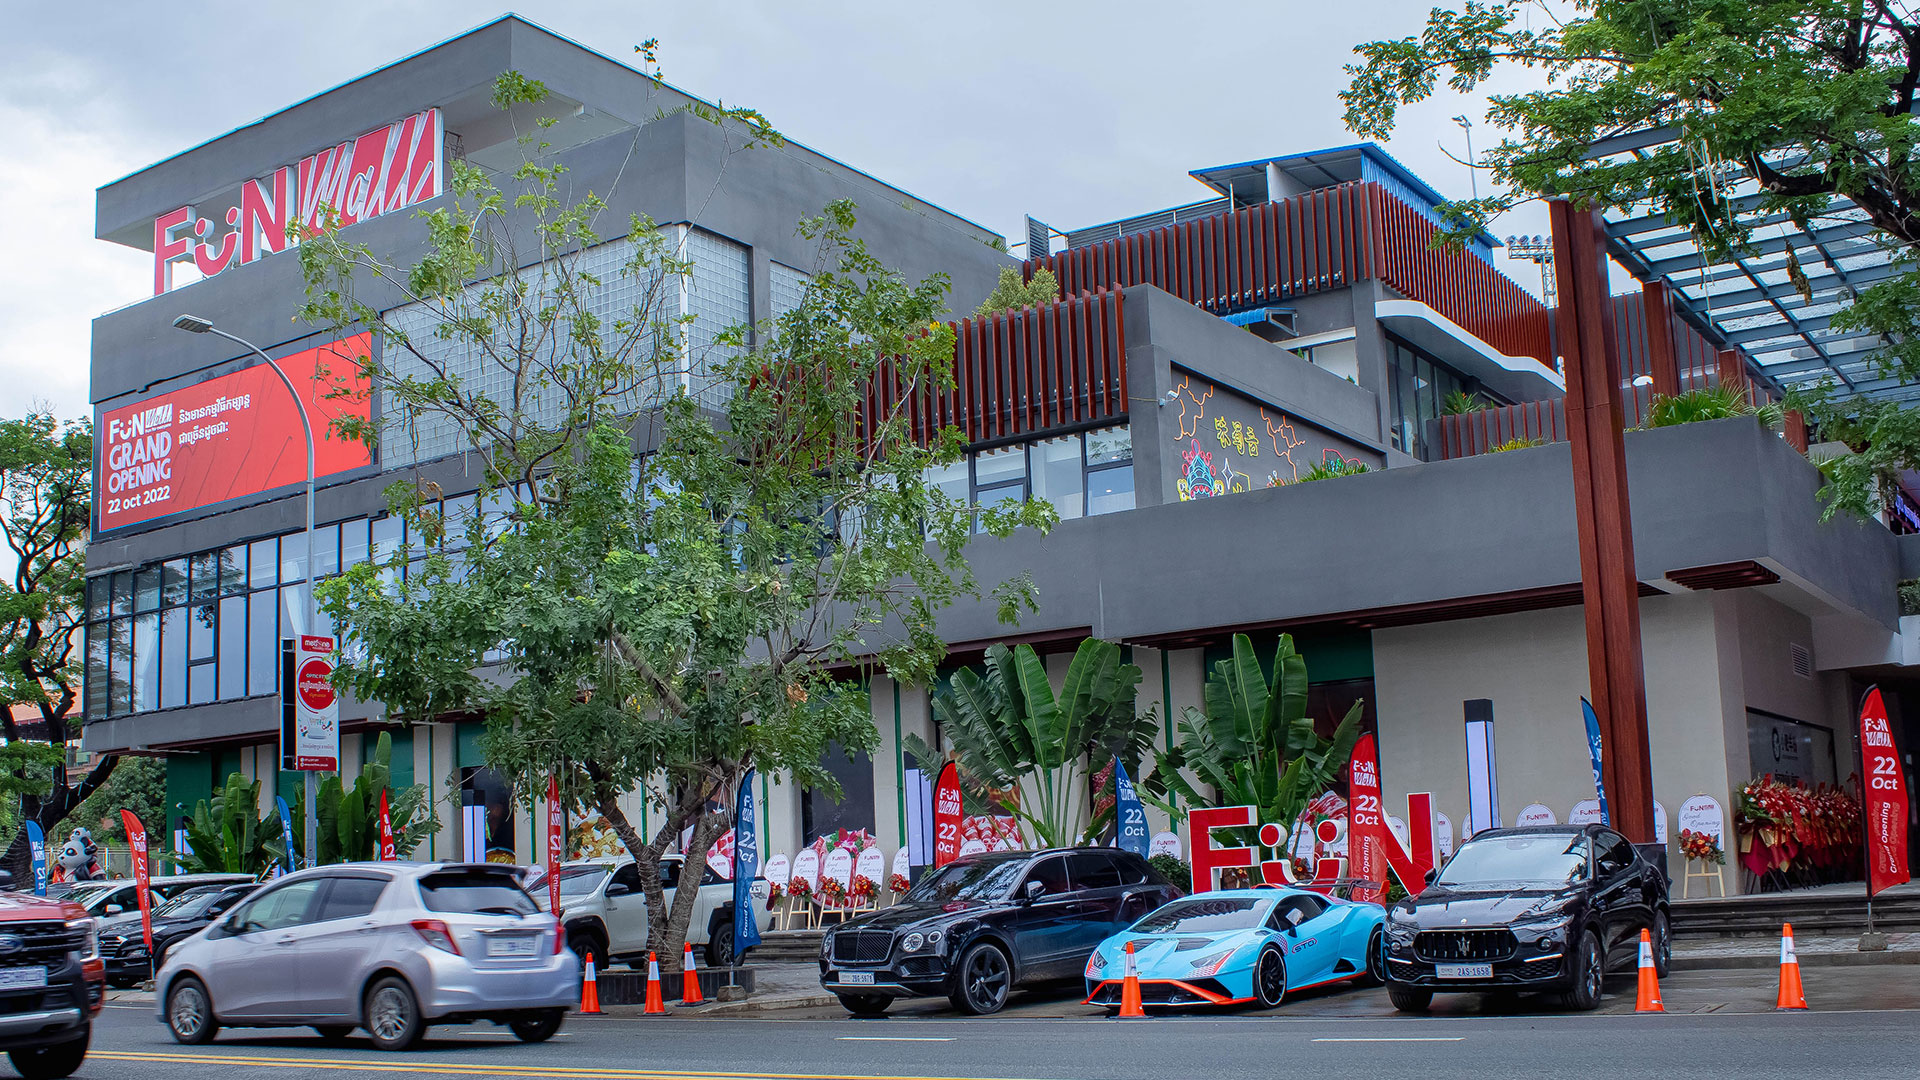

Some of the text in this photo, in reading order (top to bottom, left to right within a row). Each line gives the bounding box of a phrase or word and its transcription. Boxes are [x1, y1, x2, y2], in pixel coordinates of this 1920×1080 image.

[109, 431, 172, 471] GRAND
[108, 458, 171, 494] OPENING
[107, 485, 170, 514] 22 oct 2022
[1873, 756, 1896, 775] 22
[1871, 777, 1898, 790] Oct
[1356, 795, 1378, 812] 22
[1125, 808, 1143, 824] 22
[1355, 814, 1379, 825] Oct
[1881, 802, 1890, 844] Opening
[938, 823, 957, 840] 22
[1125, 826, 1144, 836] Oct
[738, 831, 756, 849] 22
[938, 842, 954, 854] Oct
[1362, 836, 1371, 873] Opening
[1295, 940, 1315, 953] STO
